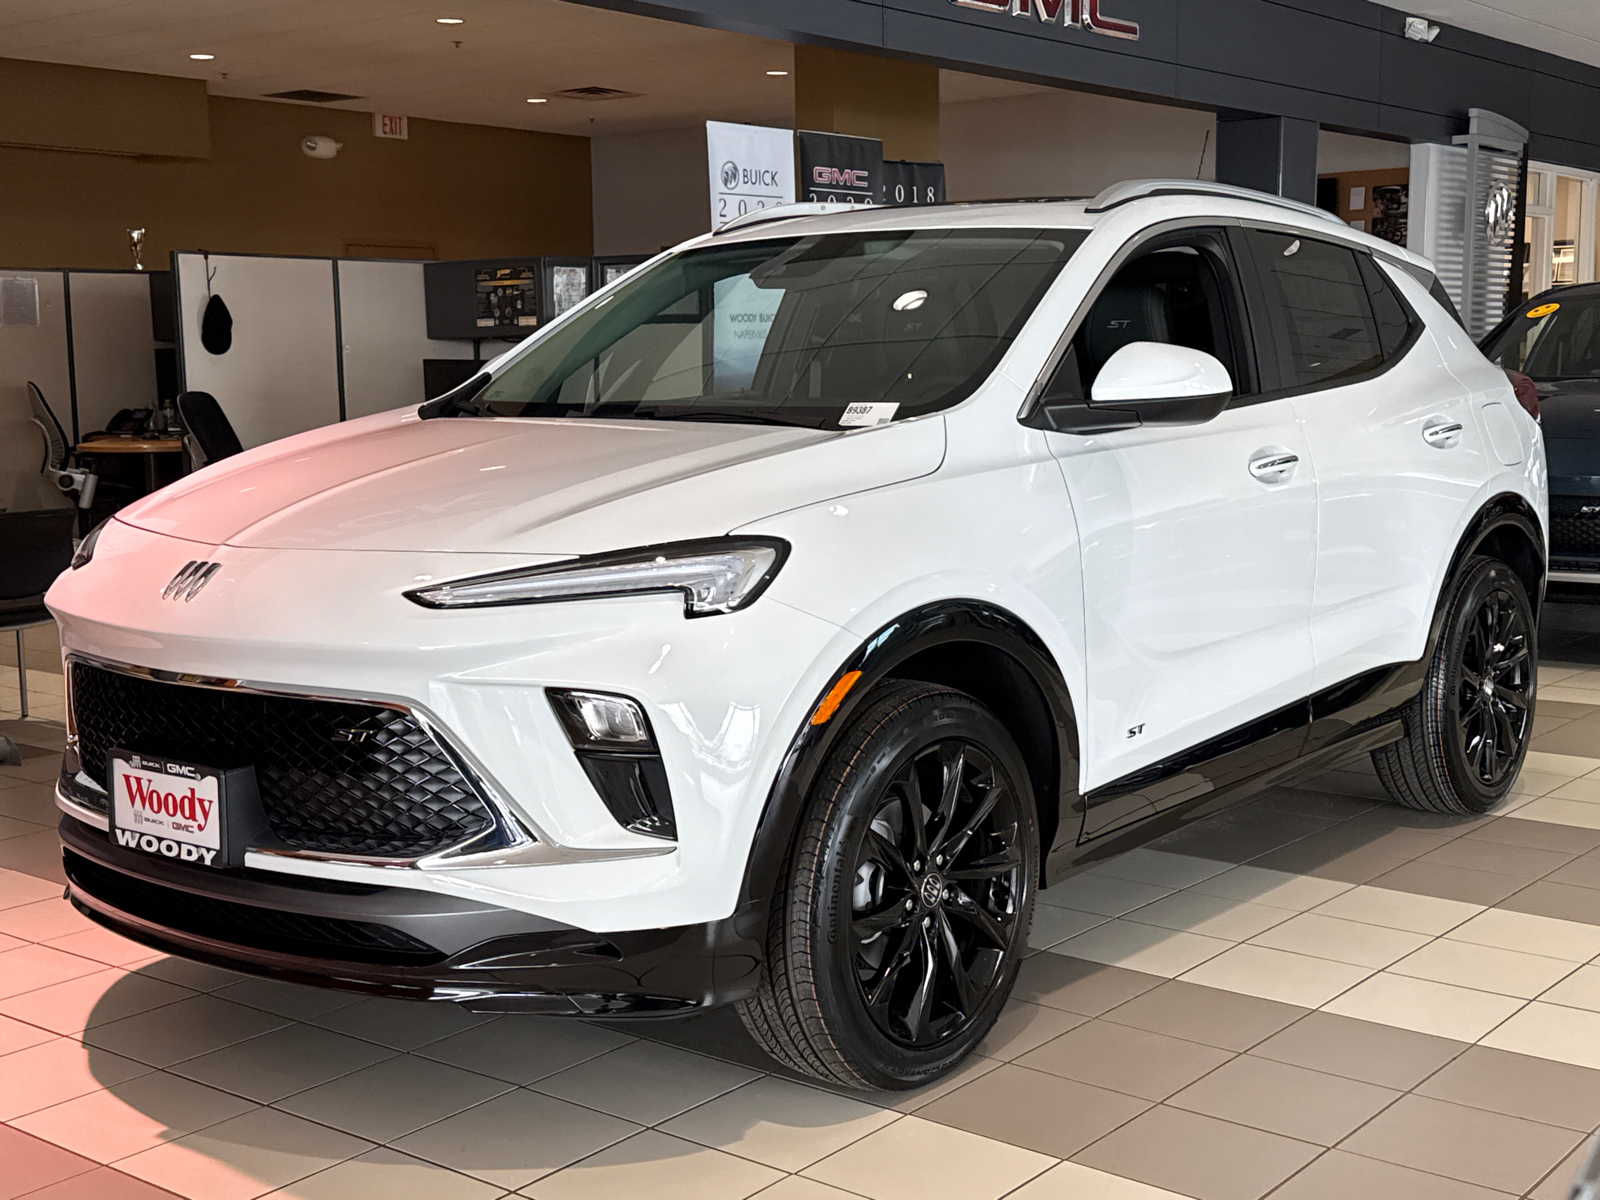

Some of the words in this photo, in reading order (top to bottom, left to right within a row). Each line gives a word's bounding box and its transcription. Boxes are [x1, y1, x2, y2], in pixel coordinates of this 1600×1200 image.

[382, 114, 402, 136] EXIT
[742, 168, 778, 187] BUICK
[813, 166, 868, 187] GMC
[883, 185, 935, 203] 018
[718, 198, 782, 217] 20
[729, 313, 757, 323] WOODY
[1107, 320, 1131, 328] ST
[1126, 723, 1145, 739] ST
[142, 760, 161, 768] BUICK
[167, 763, 195, 776] GMC
[122, 773, 213, 831] Woody
[144, 817, 164, 826] BUICK
[172, 822, 194, 834] GMC
[115, 828, 217, 866] WOODY
[826, 851, 846, 945] Continental
